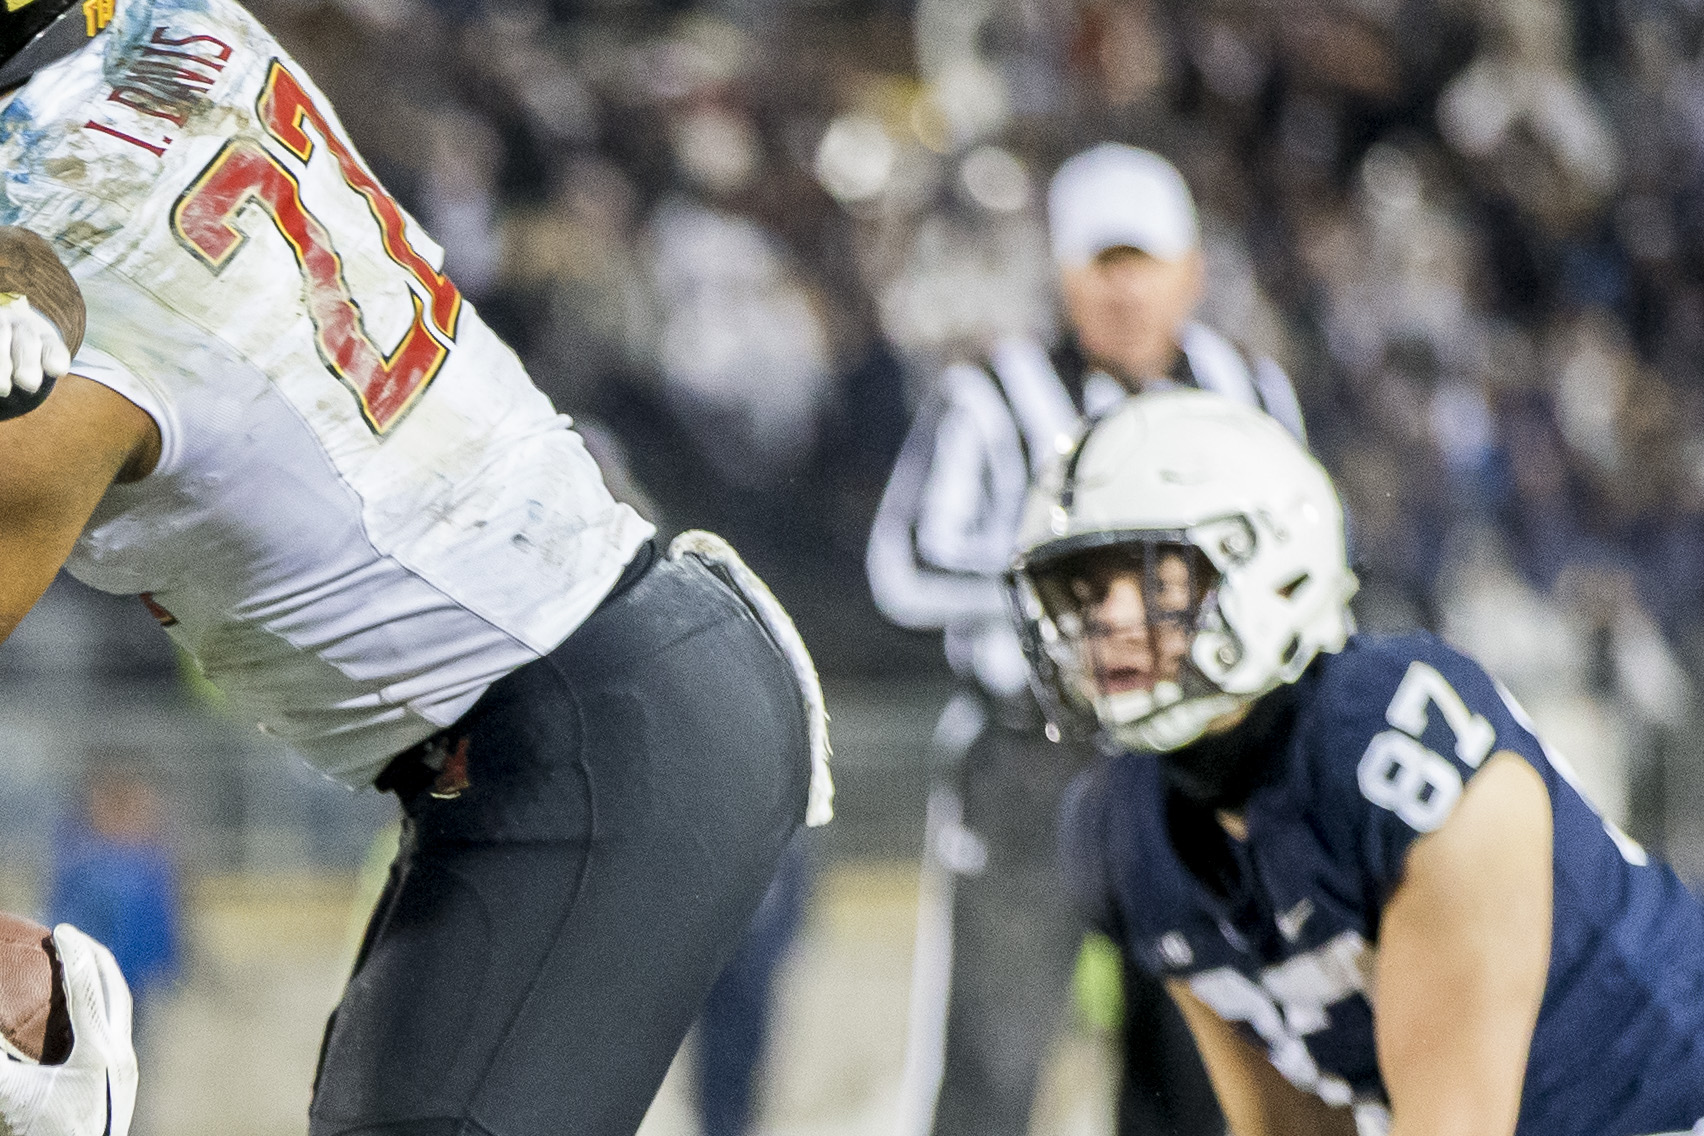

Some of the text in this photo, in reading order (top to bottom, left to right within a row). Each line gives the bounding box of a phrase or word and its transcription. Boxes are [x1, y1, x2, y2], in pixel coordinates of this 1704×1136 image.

[84, 120, 173, 158] I.
[170, 57, 462, 442] 22
[1357, 661, 1496, 833] 87
